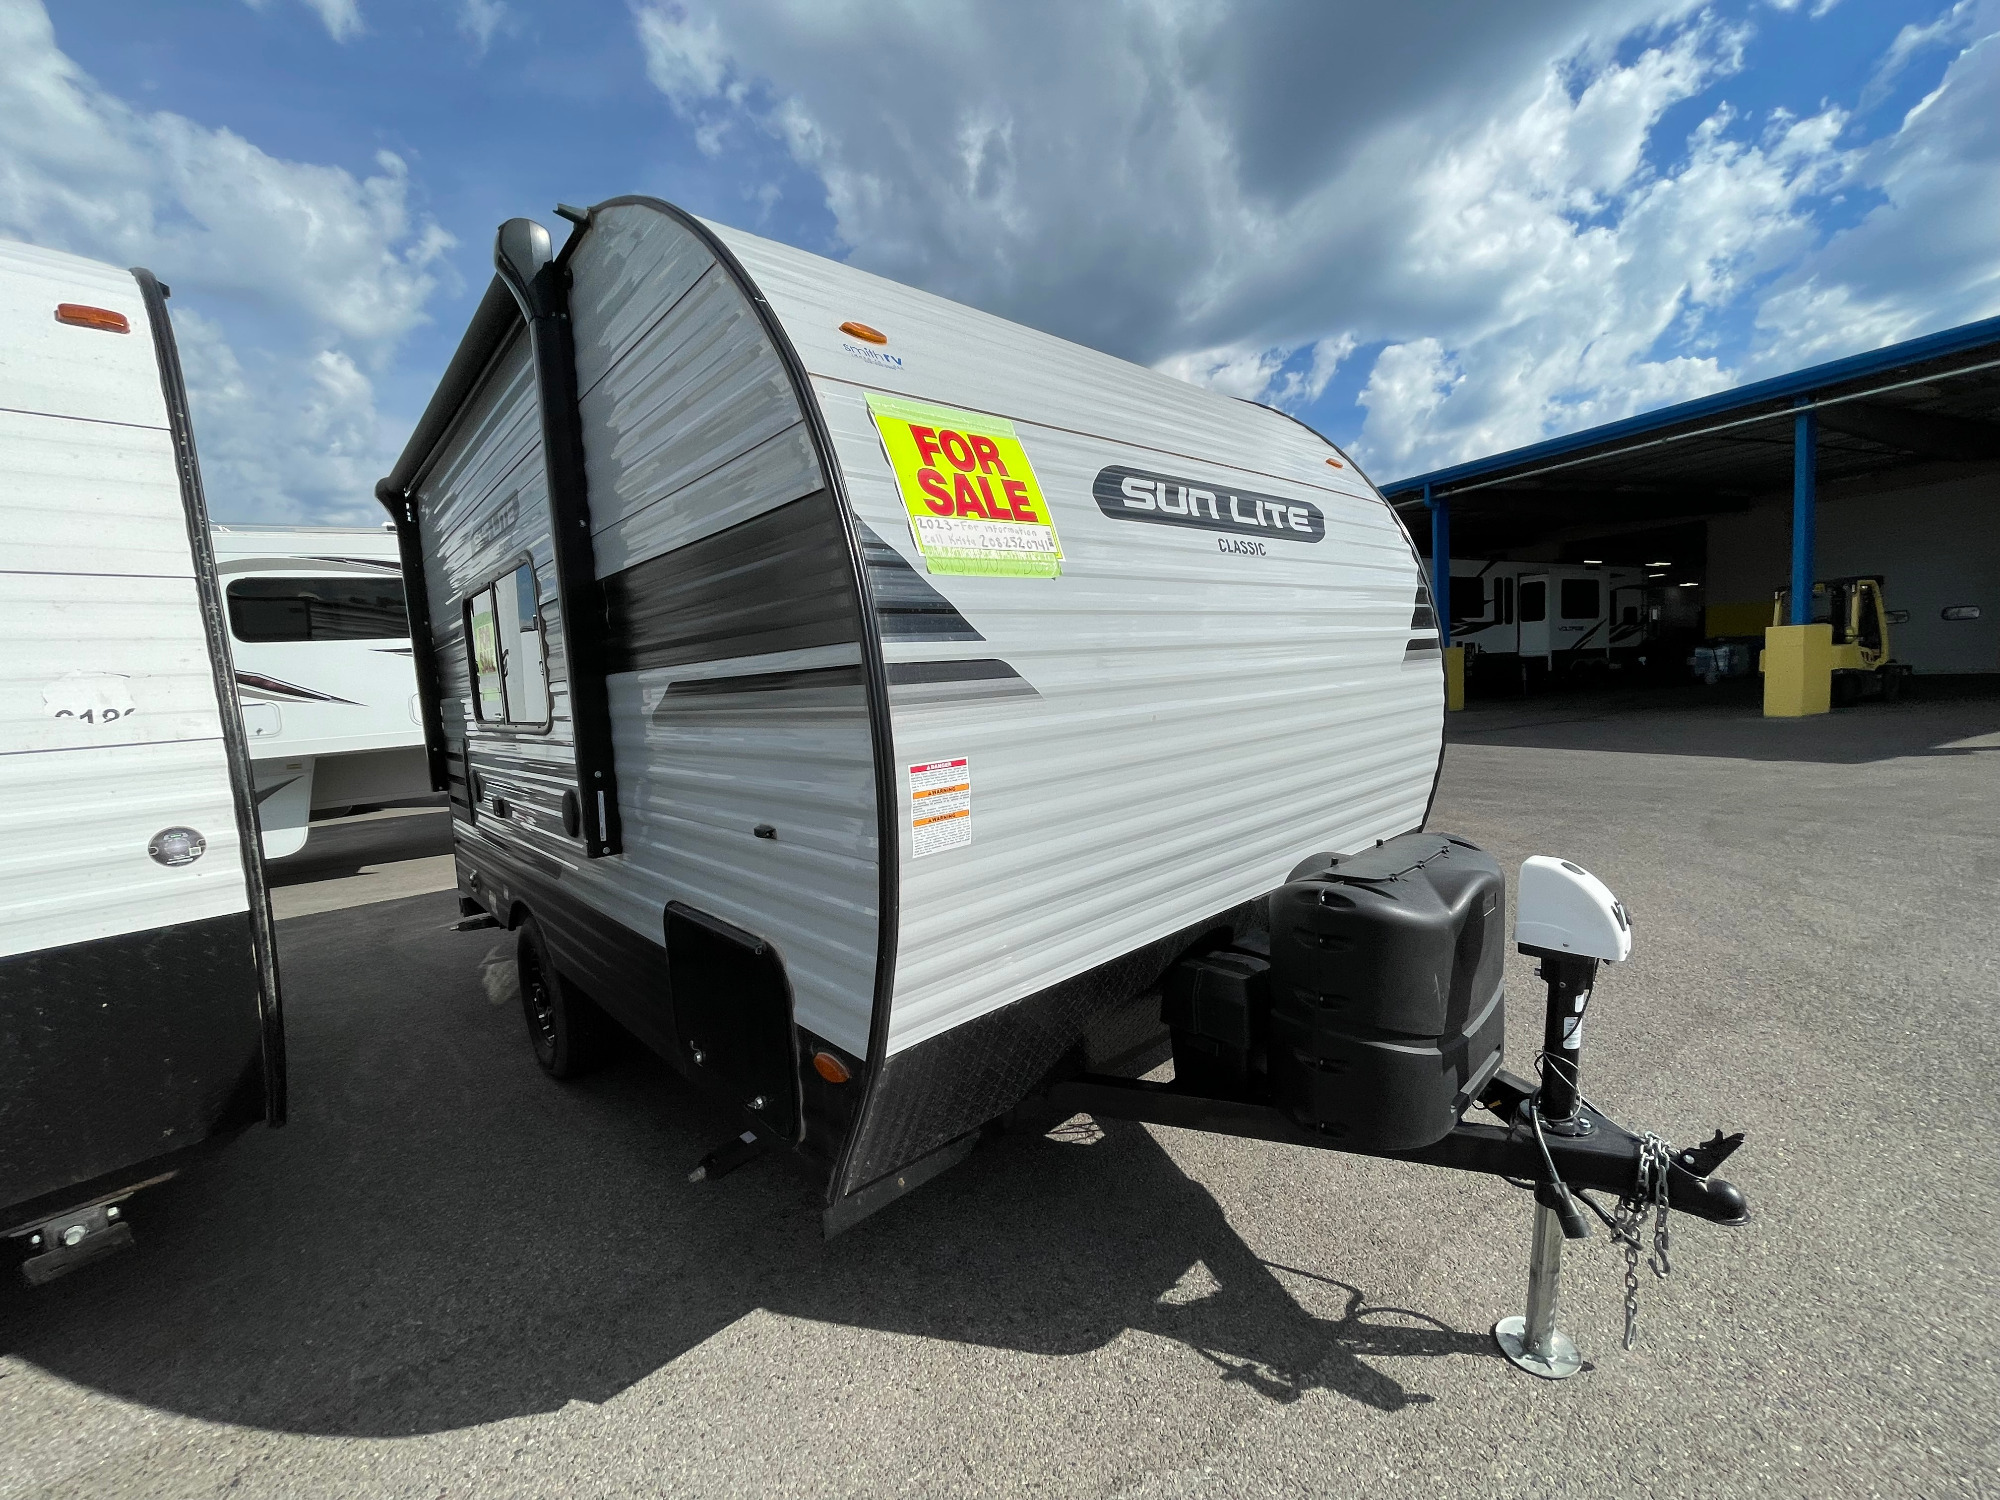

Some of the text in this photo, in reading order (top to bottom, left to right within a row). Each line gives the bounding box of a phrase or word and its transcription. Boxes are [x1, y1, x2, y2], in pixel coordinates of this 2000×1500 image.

[908, 424, 1010, 477] FOR
[917, 467, 1038, 522] SALE
[1120, 476, 1313, 533] SUN LITE
[1218, 538, 1267, 556] CLASSIC
[55, 707, 136, 724] 19
[930, 761, 952, 770] DANGER
[932, 786, 956, 796] WARNING
[932, 812, 956, 822] WARNING
